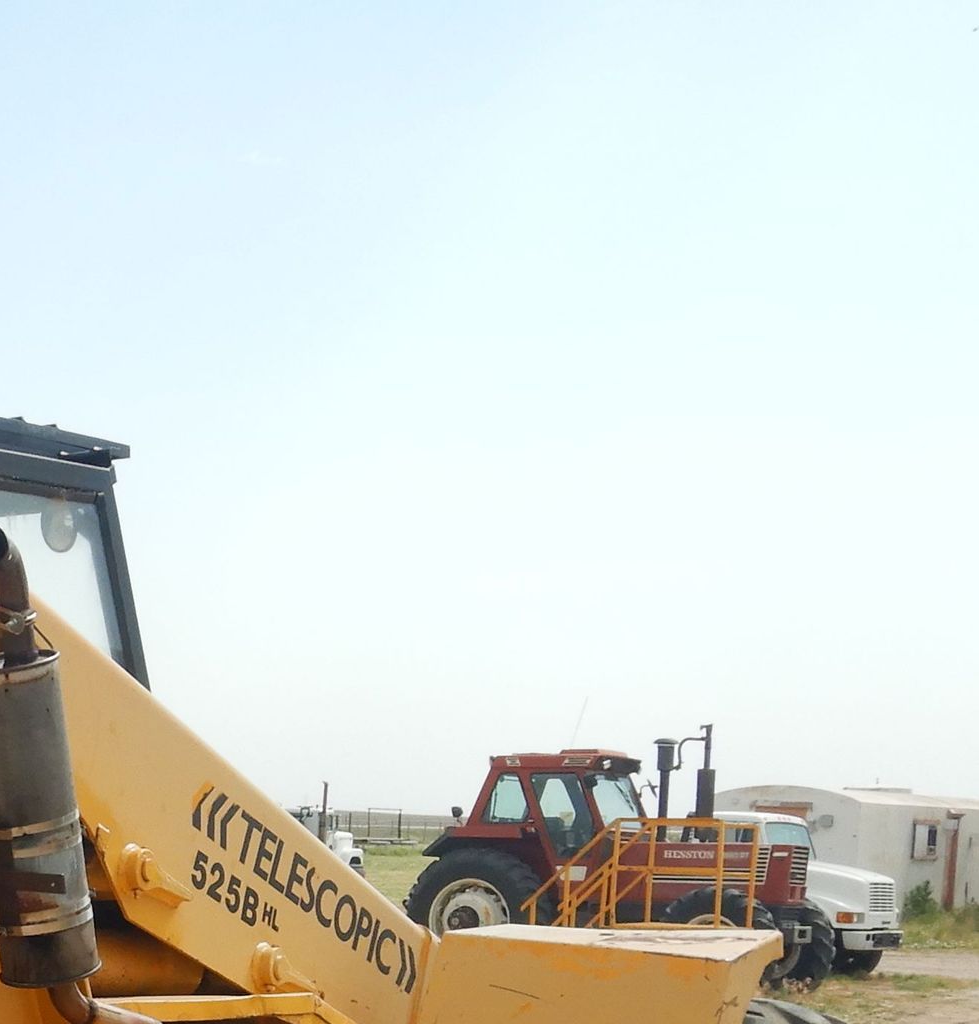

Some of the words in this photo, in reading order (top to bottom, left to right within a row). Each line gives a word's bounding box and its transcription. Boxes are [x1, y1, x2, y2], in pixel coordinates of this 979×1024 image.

[191, 850, 259, 927] 525B
[239, 809, 396, 975] TELESCOPIC
[663, 850, 715, 859] HESSTON
